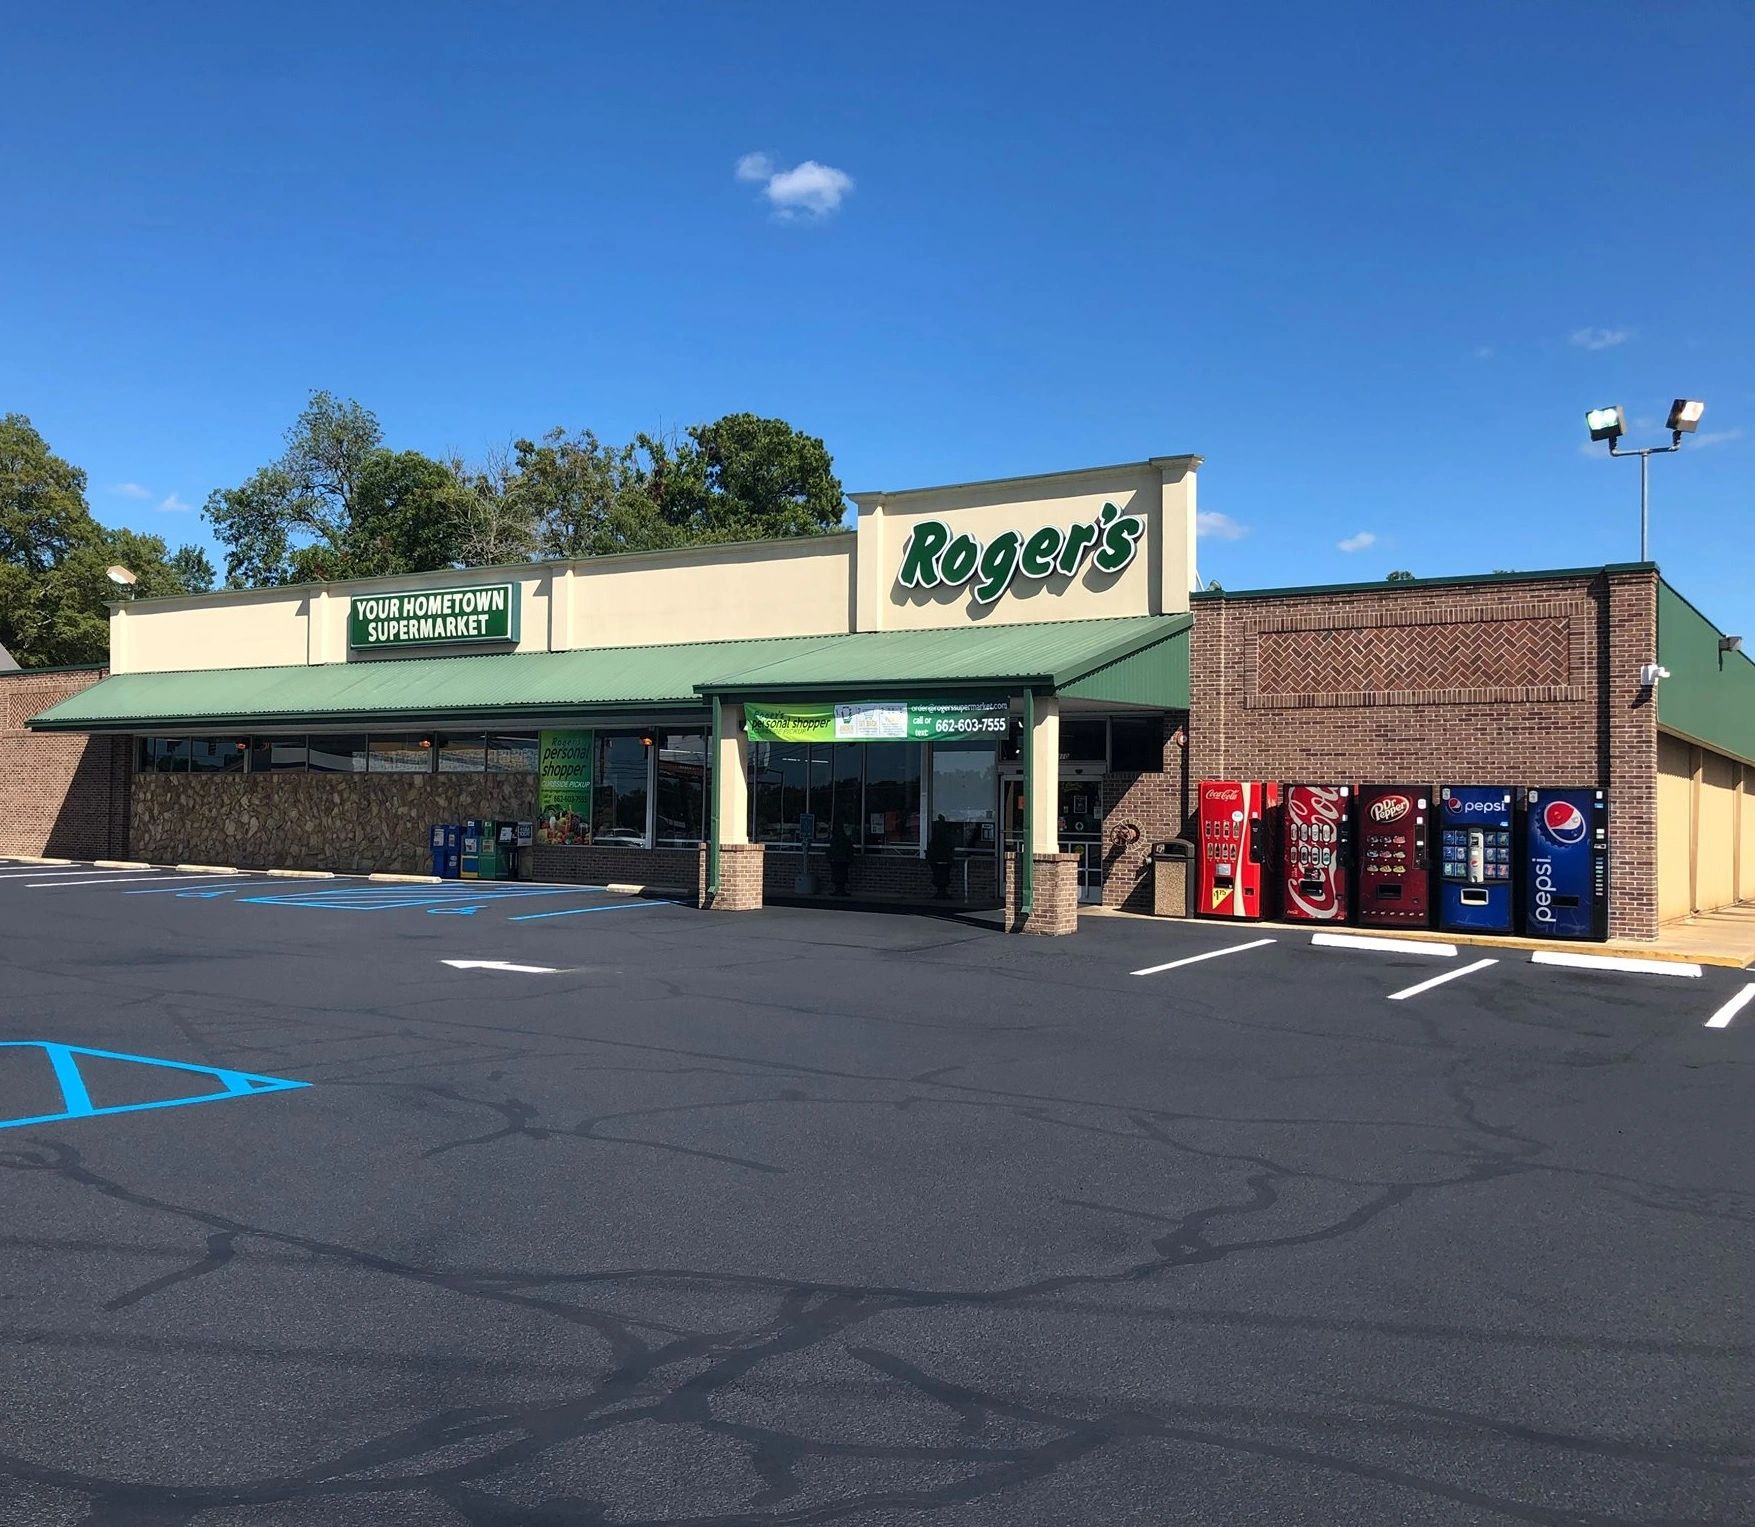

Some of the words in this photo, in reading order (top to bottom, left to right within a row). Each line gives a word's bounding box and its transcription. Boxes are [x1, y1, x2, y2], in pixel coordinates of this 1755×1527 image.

[898, 500, 1143, 605] Roger's
[356, 598, 400, 620] YOUR
[403, 590, 505, 617] HOMETOWN
[368, 614, 489, 642] SUPERMARKET
[752, 718, 790, 730] personal
[792, 717, 831, 731] shopper
[912, 716, 924, 725] call
[935, 717, 1006, 732] 662-603-7555
[914, 729, 929, 737] text
[542, 744, 590, 764] personal
[541, 760, 587, 780] shopper
[1372, 801, 1406, 821] Pepper
[1382, 798, 1397, 810] Dr
[1464, 800, 1507, 813] pepsi
[1531, 857, 1557, 922] pepsi
